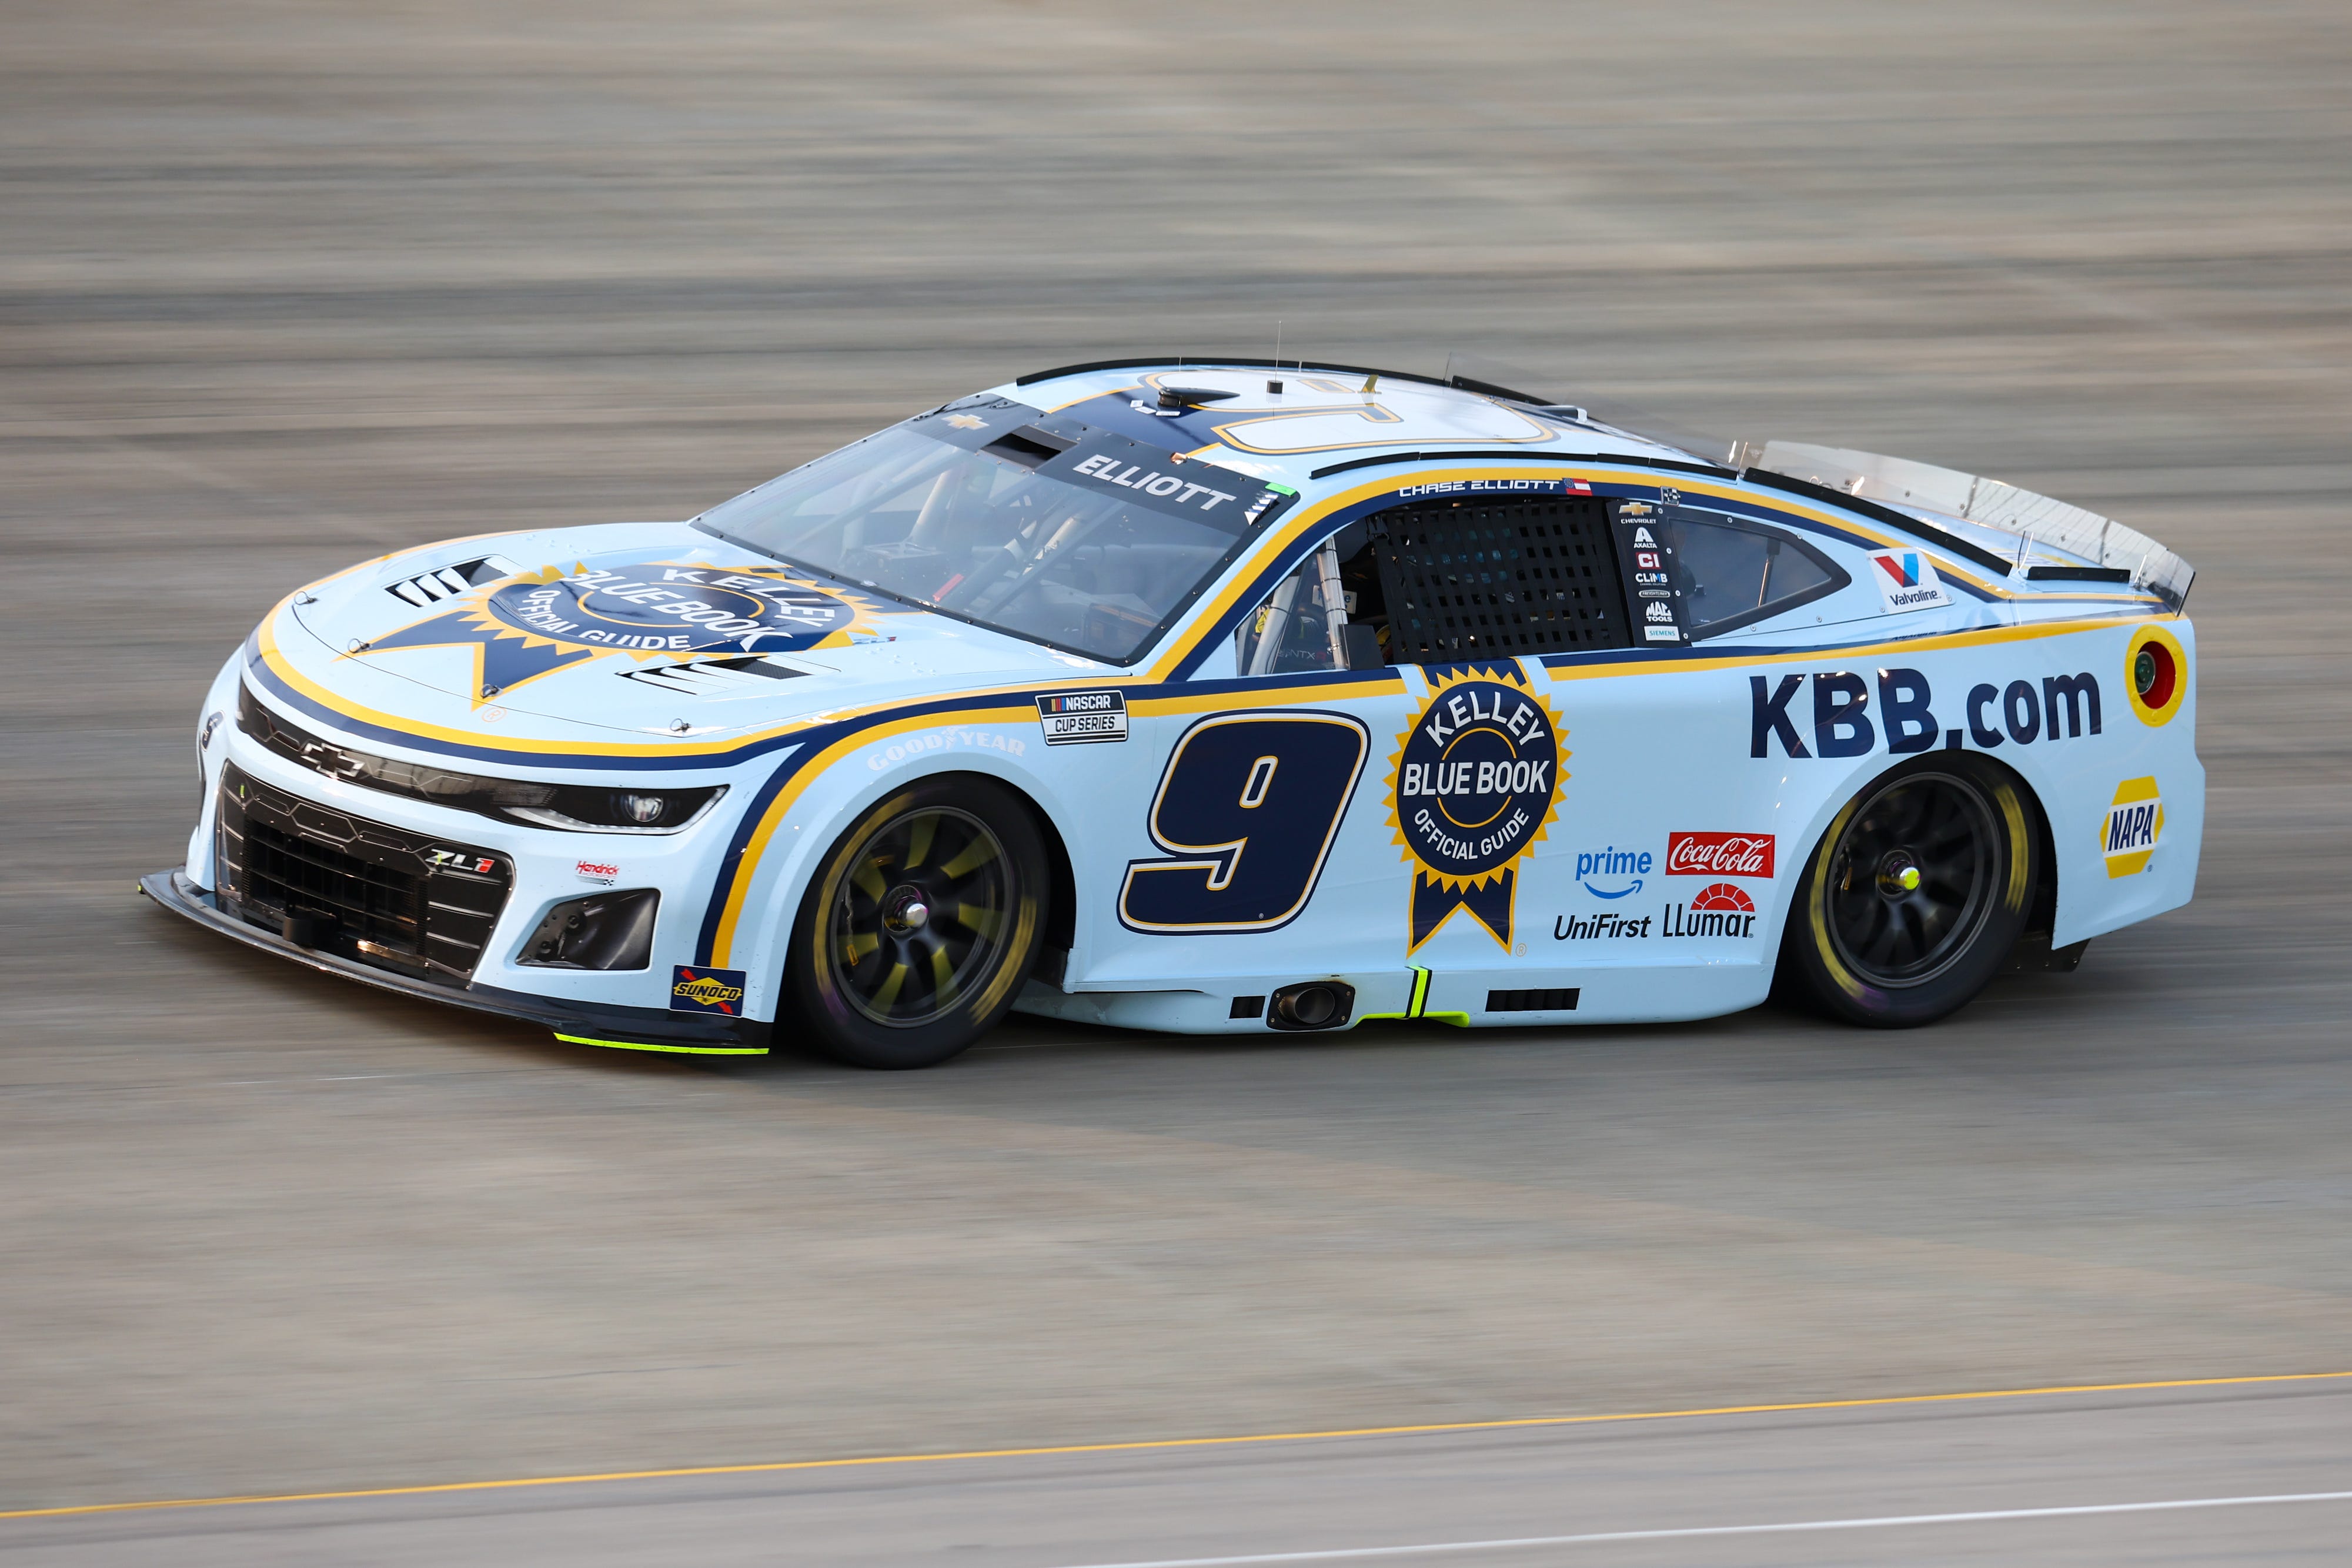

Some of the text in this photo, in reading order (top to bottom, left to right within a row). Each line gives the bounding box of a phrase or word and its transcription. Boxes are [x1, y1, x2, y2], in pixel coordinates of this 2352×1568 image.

[1072, 454, 1237, 511] ELLIOTT
[1399, 480, 1559, 497] CHASE ELLIOTT
[1638, 553, 1660, 567] CI
[560, 570, 794, 652] BLUE BOOK
[663, 569, 836, 627] KELLEY
[1646, 601, 1672, 617] MAC
[1889, 590, 1938, 606] Valvoline
[517, 590, 691, 650] OFFICIAL GUIDE
[1065, 695, 1111, 711] NASCAR
[1425, 691, 1545, 747] KELLEY
[1749, 668, 2102, 758] KBB.com
[1055, 716, 1115, 733] CUP SERIES
[867, 731, 1026, 771] GOODYEAR
[1403, 760, 1550, 795] BLUE BOOK
[1117, 708, 1371, 937] 9
[1414, 808, 1529, 860] OFFICIAL GUIDE
[2108, 804, 2154, 851] NAPA
[425, 849, 495, 872] ZL1
[576, 860, 620, 875] Hendrick
[1576, 846, 1652, 881] prime
[1669, 836, 1772, 872] Coca-Cola
[1554, 914, 1651, 940] UniFirst
[1663, 904, 1756, 938] LLumar
[675, 984, 741, 1001] SUNOCO
